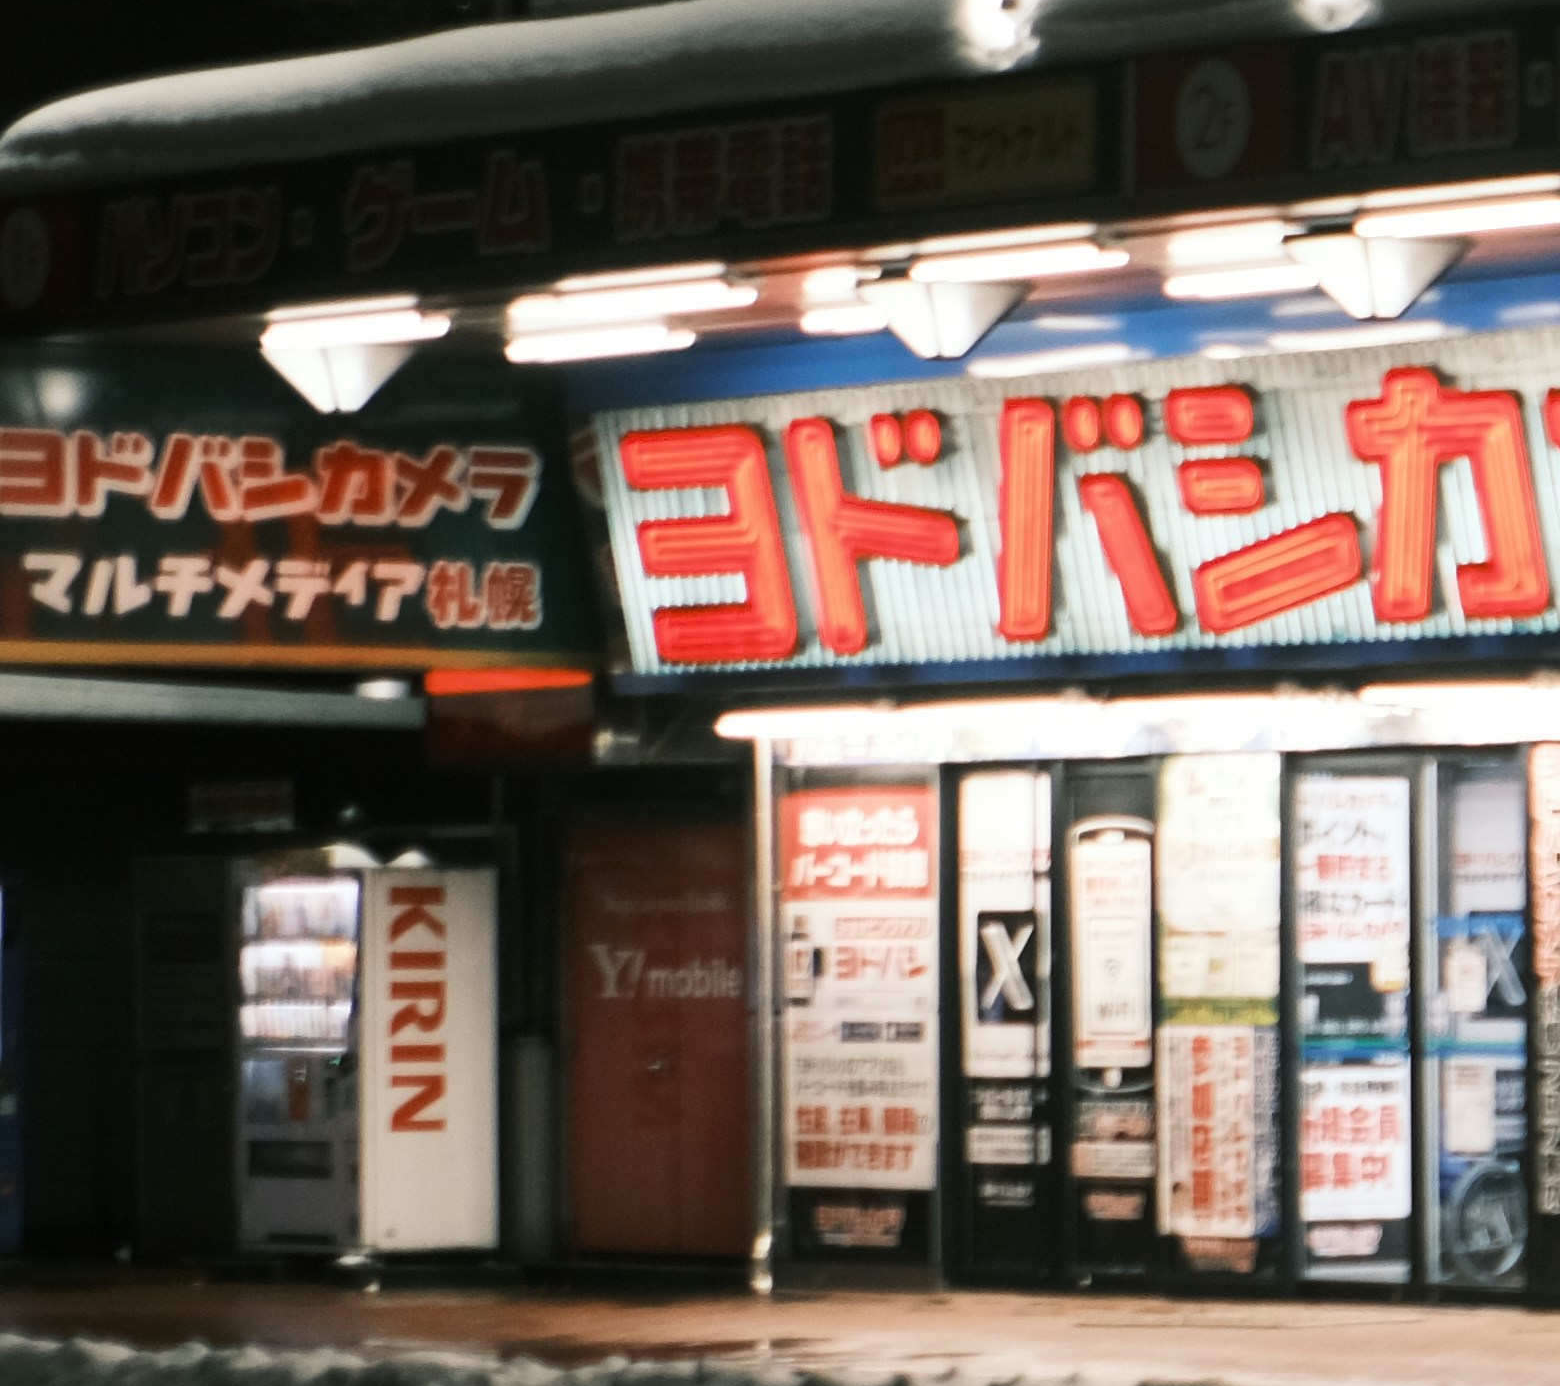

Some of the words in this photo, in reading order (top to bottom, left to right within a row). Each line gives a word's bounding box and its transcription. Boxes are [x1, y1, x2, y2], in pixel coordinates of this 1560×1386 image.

[0, 427, 540, 530] ヨドバシカメラ
[22, 551, 543, 633] マルチメディア札幌
[388, 886, 447, 1134] KIRIN
[980, 921, 1034, 1011] X
